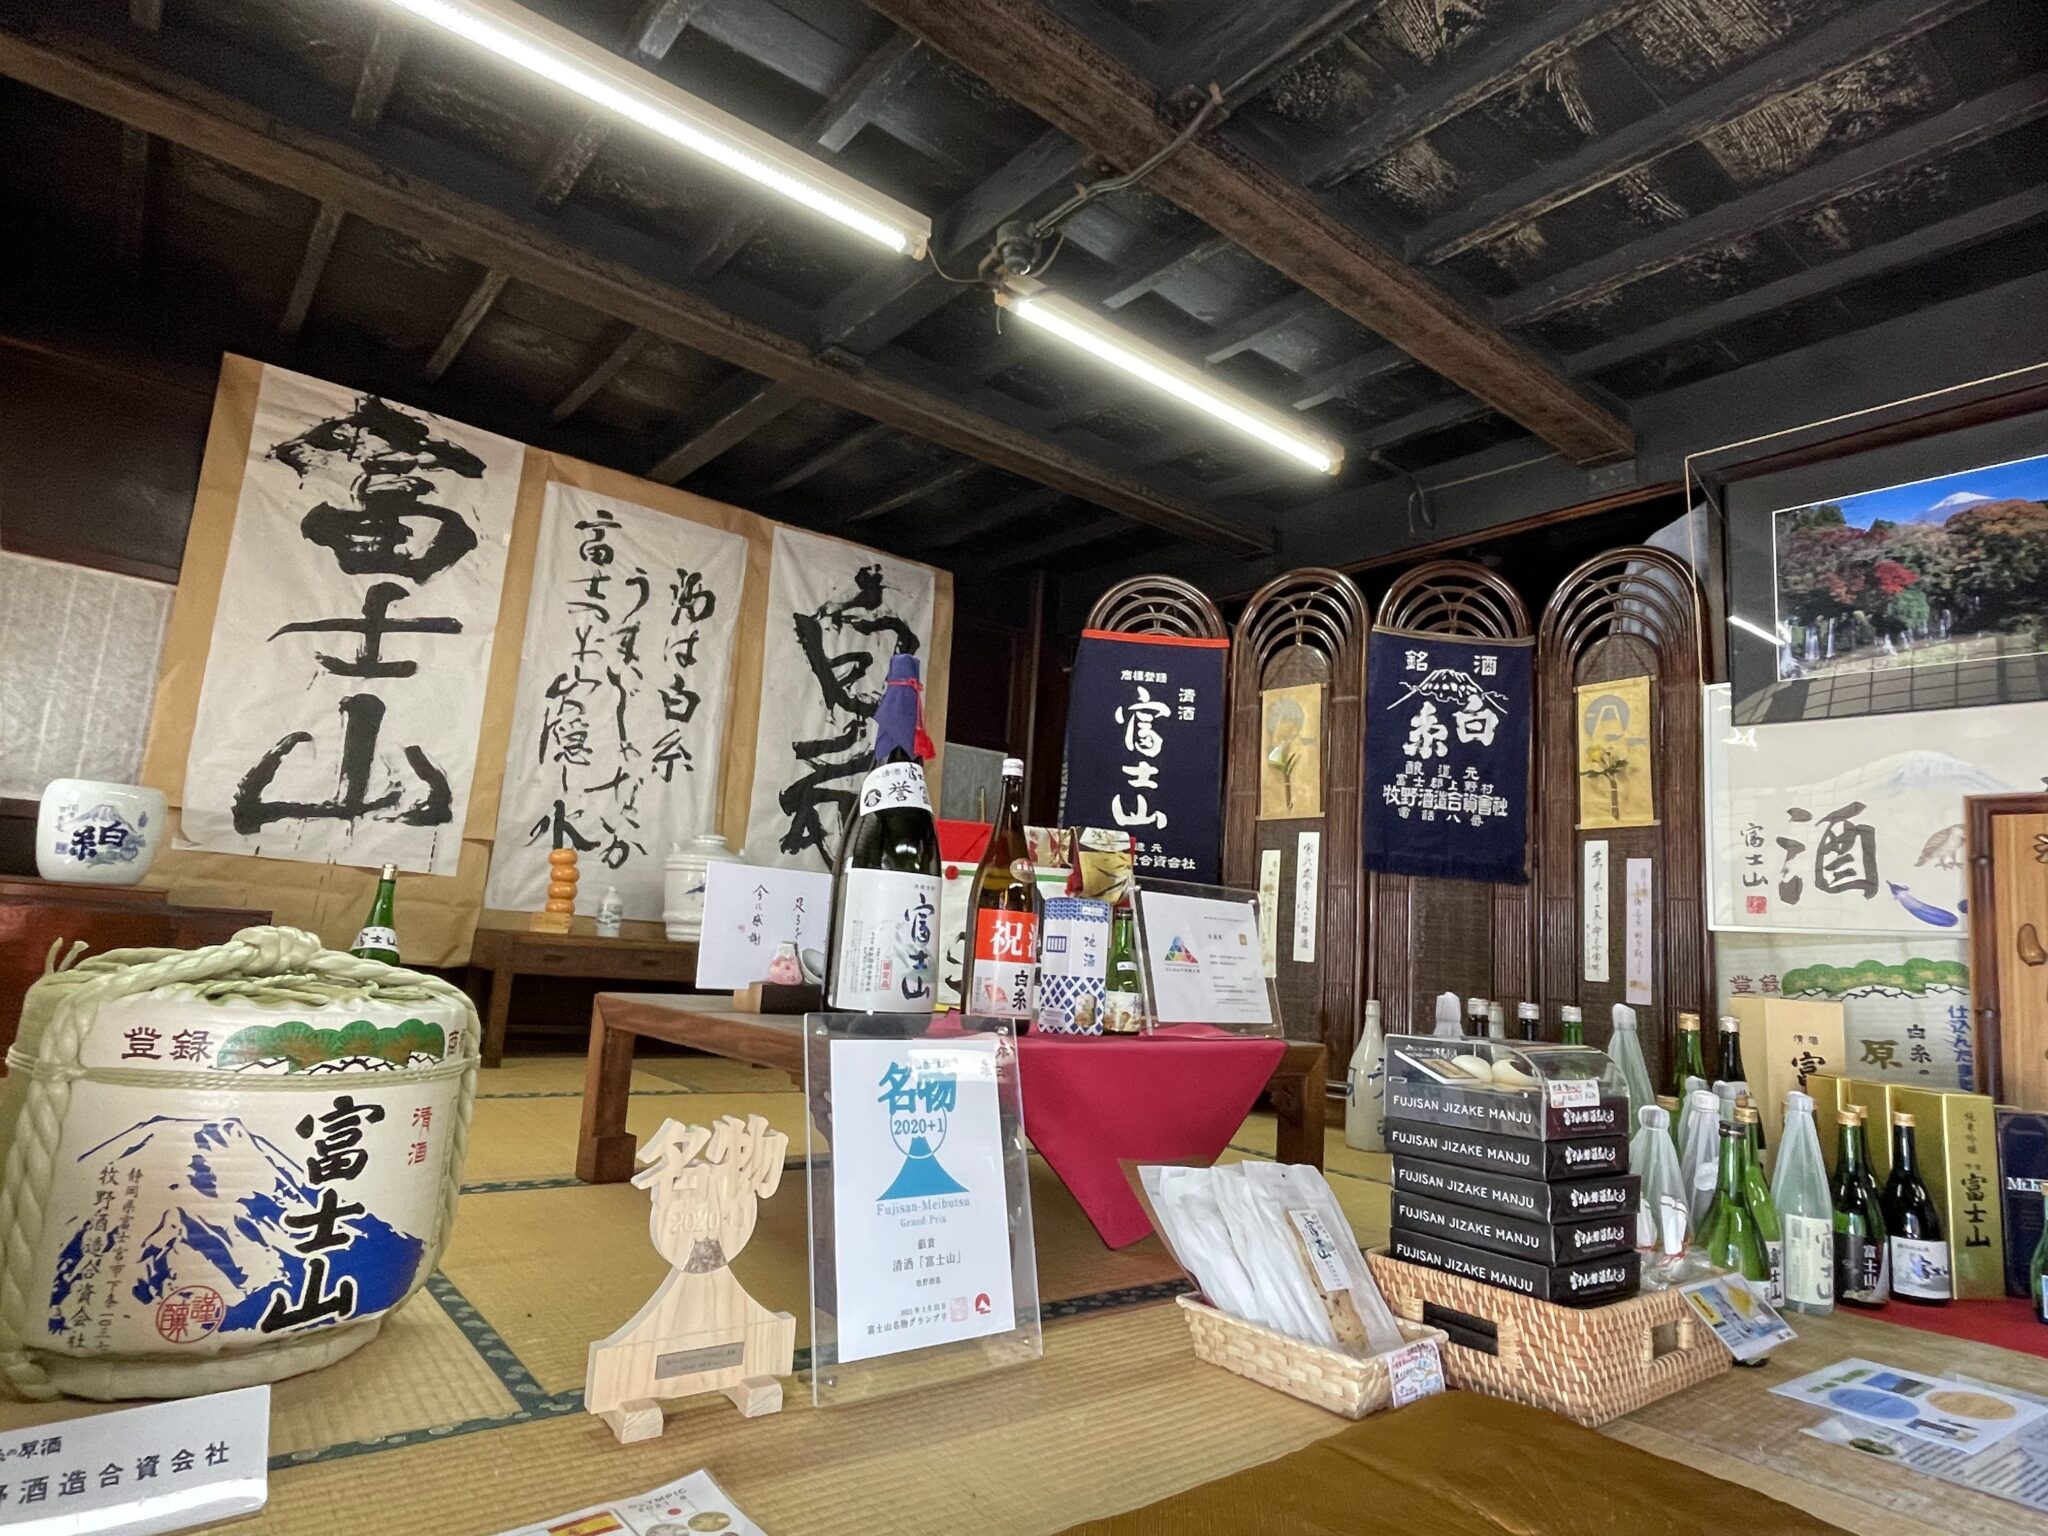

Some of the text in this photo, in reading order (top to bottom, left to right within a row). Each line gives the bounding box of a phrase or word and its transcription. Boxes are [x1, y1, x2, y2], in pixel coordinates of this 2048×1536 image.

[232, 393, 488, 835] 富士山
[1178, 688, 1196, 721] 清酒
[1111, 685, 1172, 830] 富士山
[1739, 822, 1769, 888] 富士山
[1775, 801, 1880, 906] 酒
[902, 892, 936, 1001] 富士山
[1012, 969, 1030, 1012] 白糸
[1729, 974, 1782, 995] 登録
[121, 1026, 214, 1062] 登録
[877, 1061, 957, 1116] 名物
[1393, 1095, 1532, 1125] FUJISAN JIZAKE MANJU
[407, 1106, 434, 1166] 清酒
[1392, 1131, 1530, 1166] FUJISAN JIZAKE MANJU
[876, 1198, 970, 1216] Fujisan-Meibutsu
[1398, 1168, 1535, 1209] FUJISAN JIZAKE MANJU
[1960, 1173, 1991, 1249] 富士山
[260, 1095, 385, 1334] 富士山
[900, 1215, 926, 1228] Grand
[1398, 1204, 1540, 1249] FUJISAN JIZAKE MANJU
[1396, 1243, 1534, 1293] FUJISAN JIZAKE MANJU
